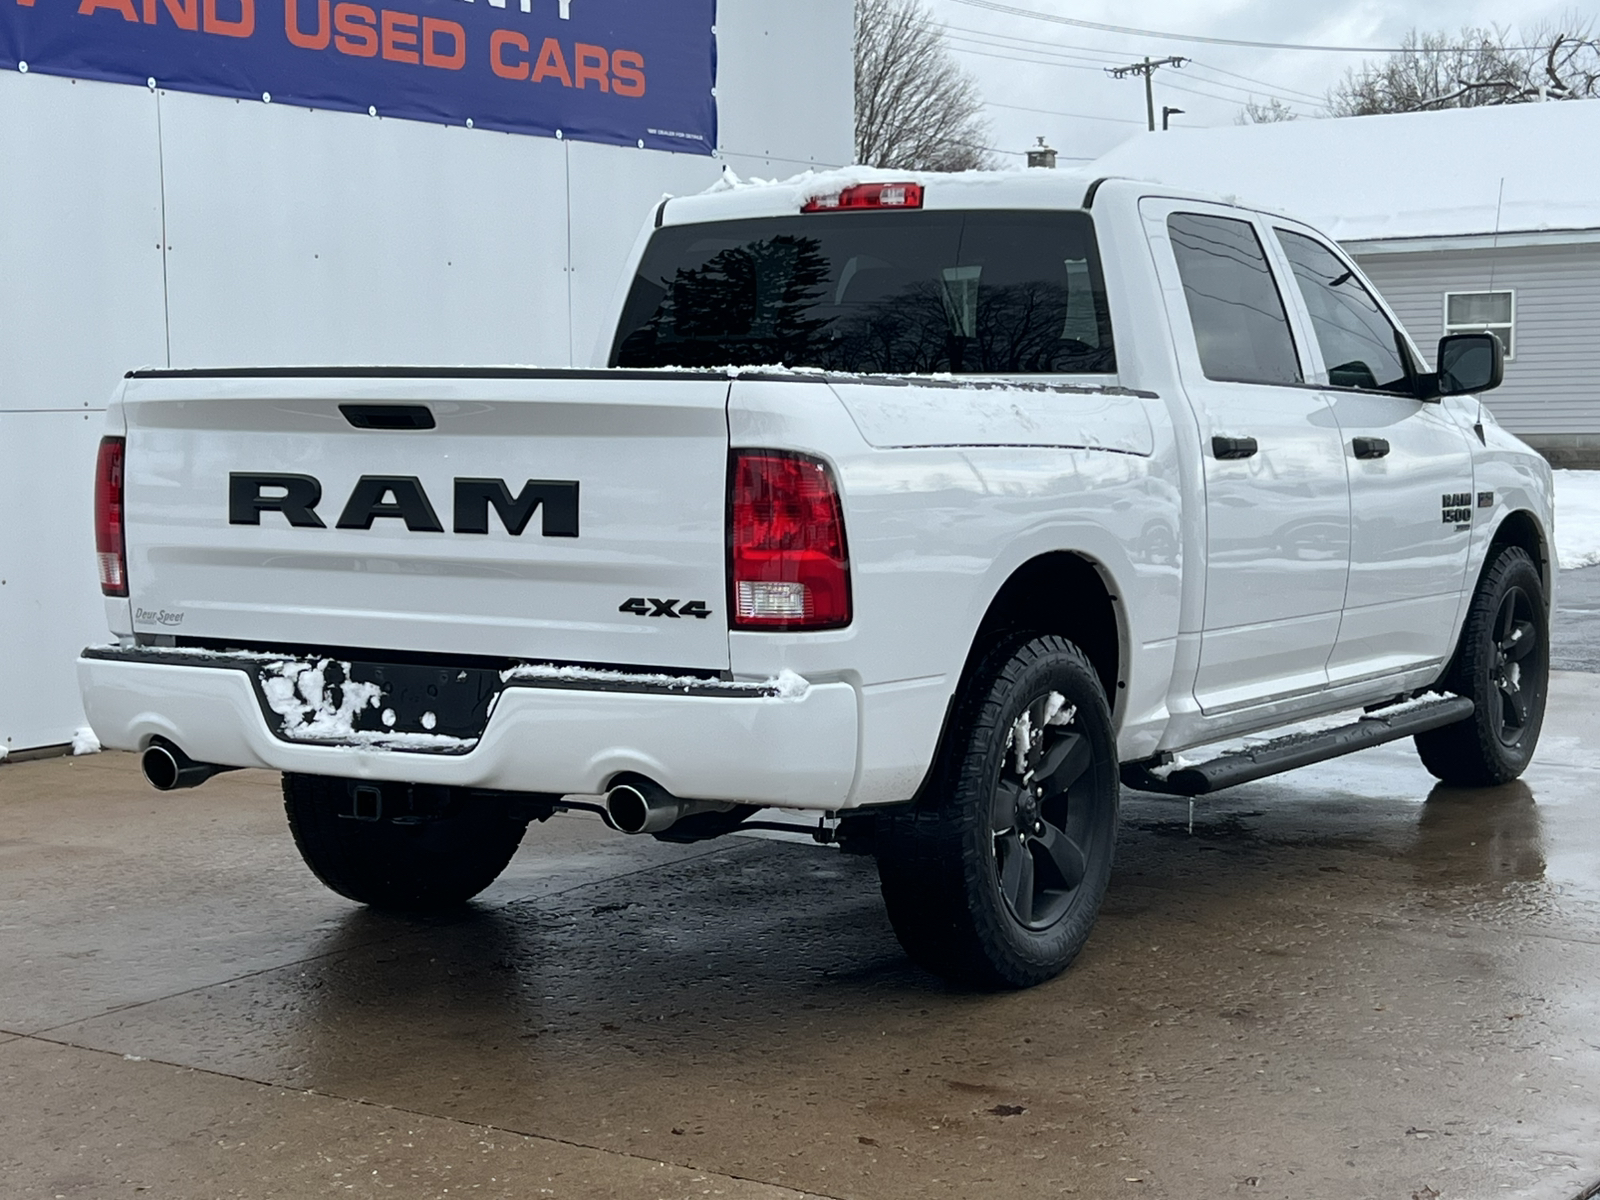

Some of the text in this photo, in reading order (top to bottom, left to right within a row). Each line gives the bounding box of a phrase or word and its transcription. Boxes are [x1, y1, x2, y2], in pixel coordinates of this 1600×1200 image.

[285, 0, 466, 70] USED
[490, 29, 645, 97] CARS
[229, 471, 579, 538] RAM
[1442, 508, 1471, 523] 1500
